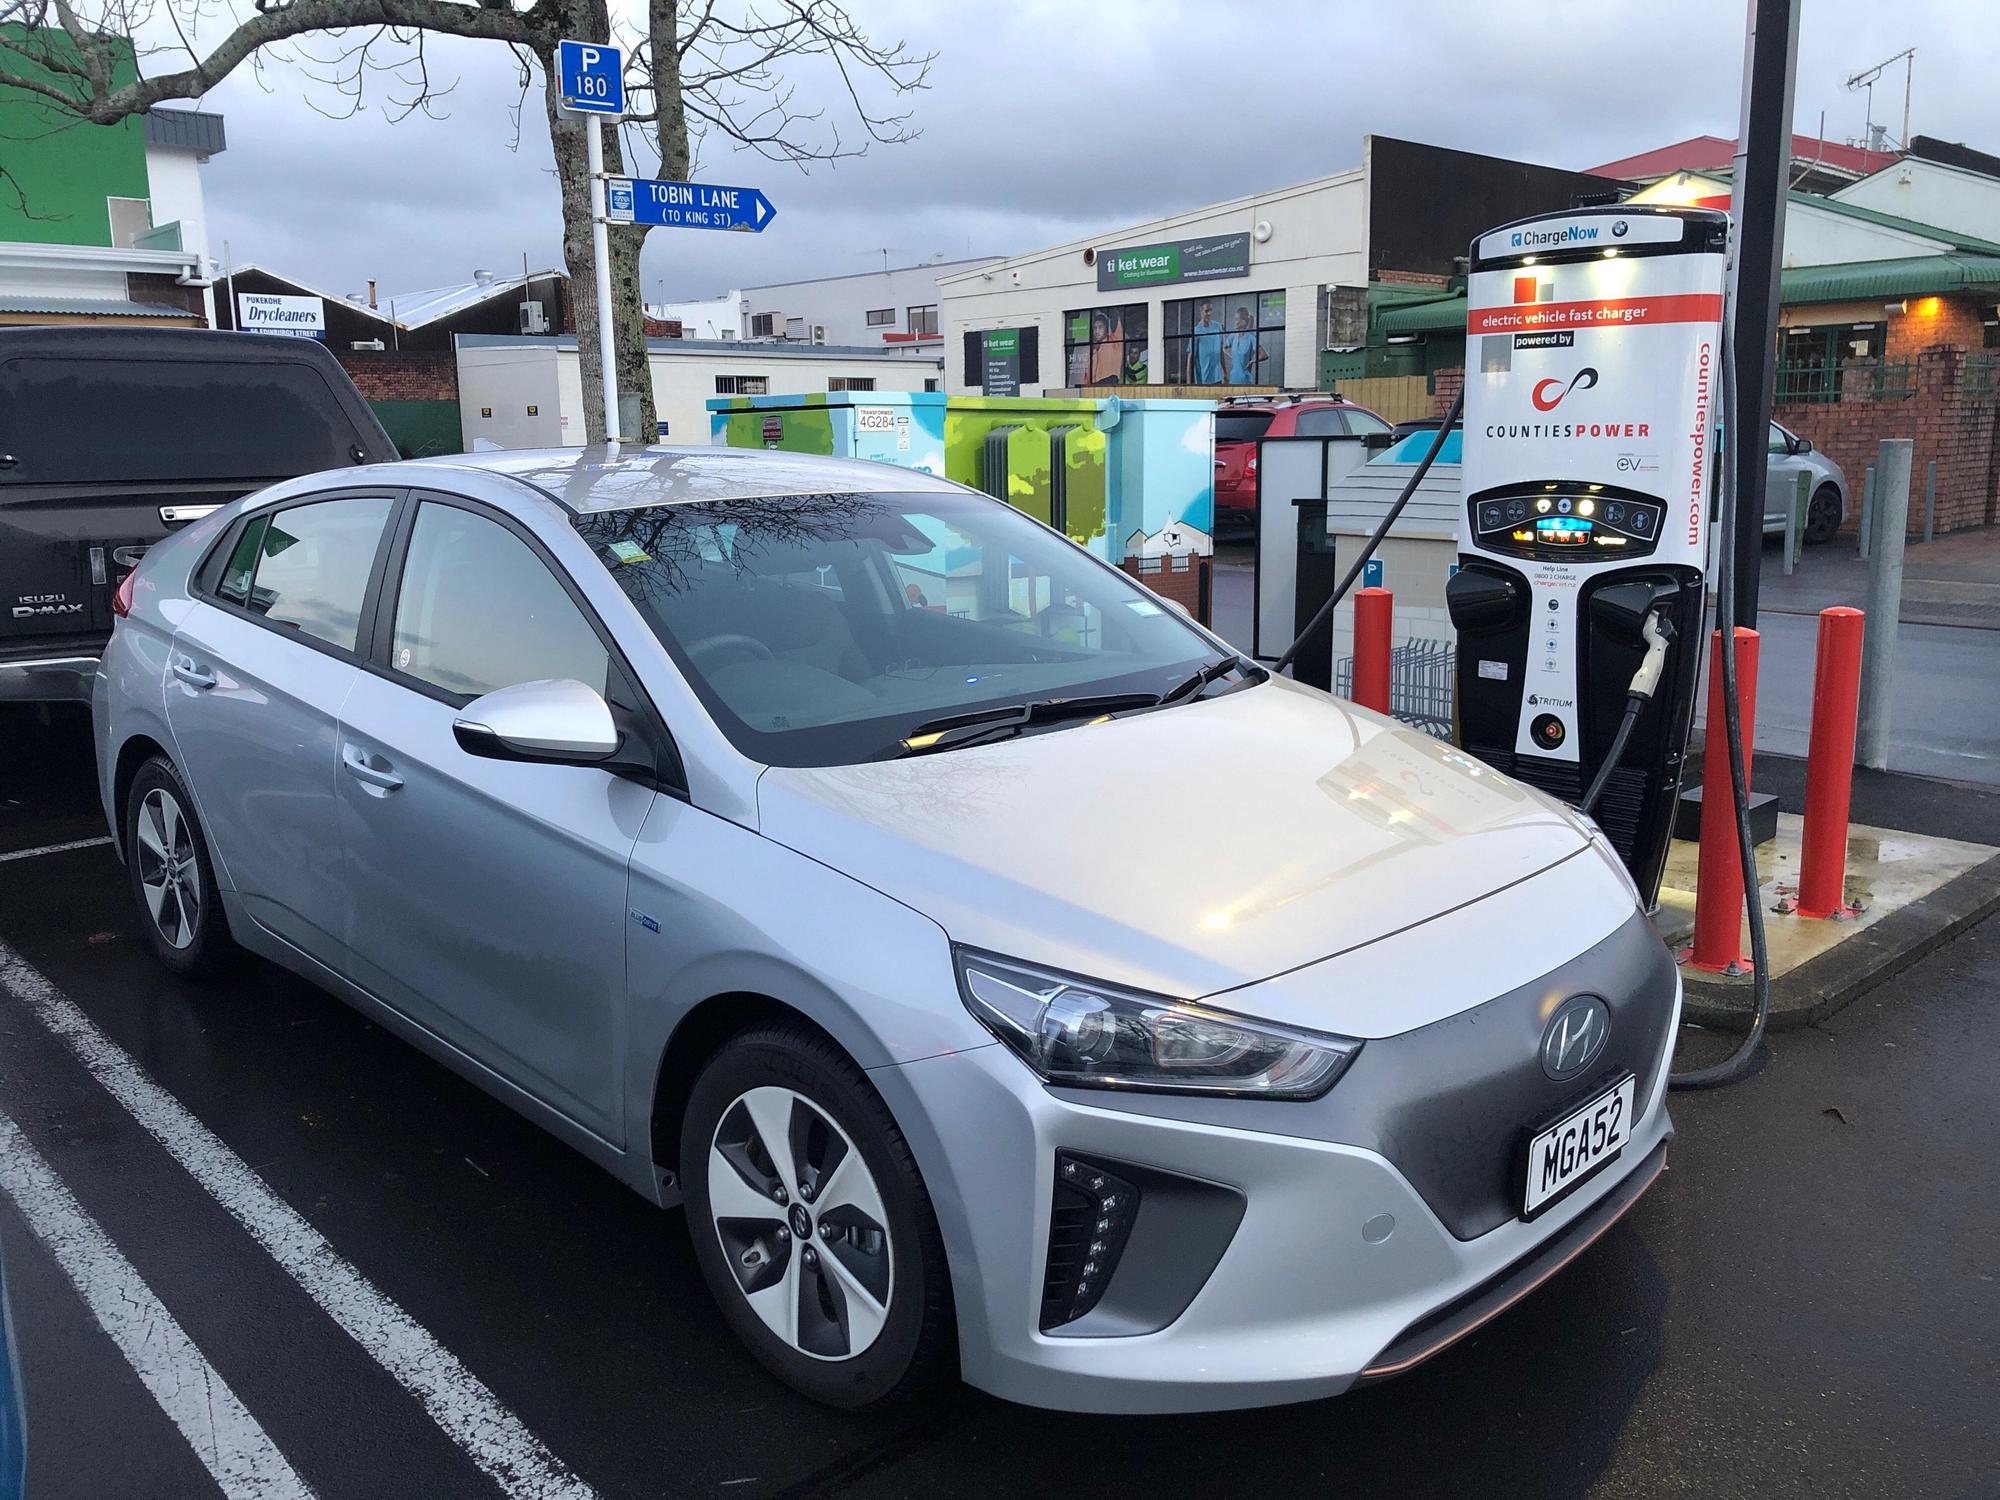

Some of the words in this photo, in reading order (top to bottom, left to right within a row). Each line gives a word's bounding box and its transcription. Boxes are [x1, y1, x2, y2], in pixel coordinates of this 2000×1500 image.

[582, 47, 600, 72] P
[576, 75, 607, 97] 180
[650, 184, 693, 206] TOBIN
[701, 188, 740, 209] LANE
[662, 207, 681, 223] (TO
[685, 211, 709, 224] KING
[713, 212, 731, 227] ST)
[1524, 226, 1599, 246] ChargeNow
[1139, 256, 1170, 269] wear
[246, 296, 282, 305] PUKEKOHE
[248, 306, 317, 324] Drycleaners
[1482, 313, 1522, 327] electric
[1524, 310, 1566, 324] vehicle
[1569, 308, 1593, 320] fast
[1596, 306, 1647, 321] charger
[1515, 335, 1556, 348] powered
[1559, 333, 1572, 346] by
[859, 415, 895, 428] 4G284
[1688, 343, 1711, 545] countiespower.com
[1367, 563, 1377, 575] P
[1542, 565, 1556, 573] Help
[18, 593, 65, 604] ISUZU
[12, 604, 83, 618] D-MAX
[1538, 697, 1573, 708] TRITIUM
[1541, 1097, 1623, 1193] MGA52
